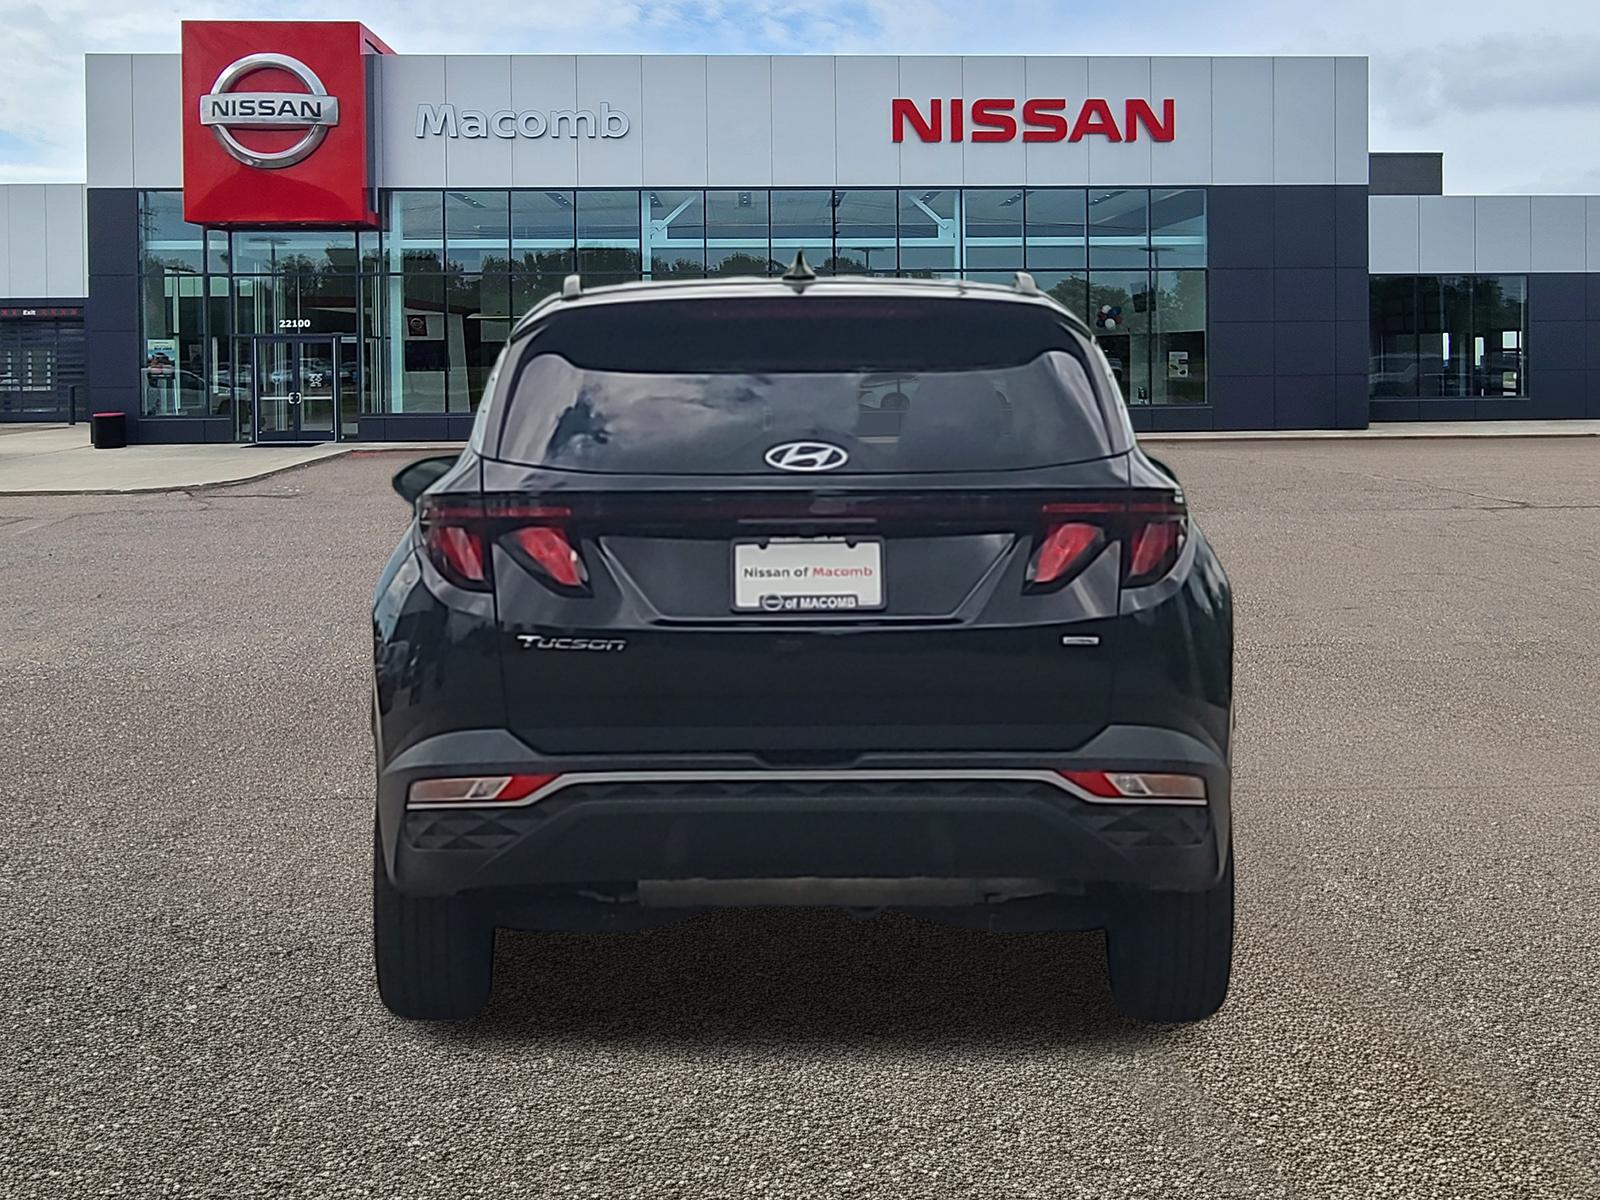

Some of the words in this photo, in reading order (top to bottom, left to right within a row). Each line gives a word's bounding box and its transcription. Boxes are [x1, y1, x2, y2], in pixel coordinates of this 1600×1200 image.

[211, 100, 322, 117] NISSAN
[415, 102, 630, 138] Macomb
[892, 98, 1175, 143] NISSAN
[279, 319, 311, 328] 22100
[743, 567, 790, 578] Nissan
[793, 567, 809, 577] of
[812, 566, 873, 577] Macomb
[784, 598, 798, 609] of
[800, 597, 856, 609] MACOMB
